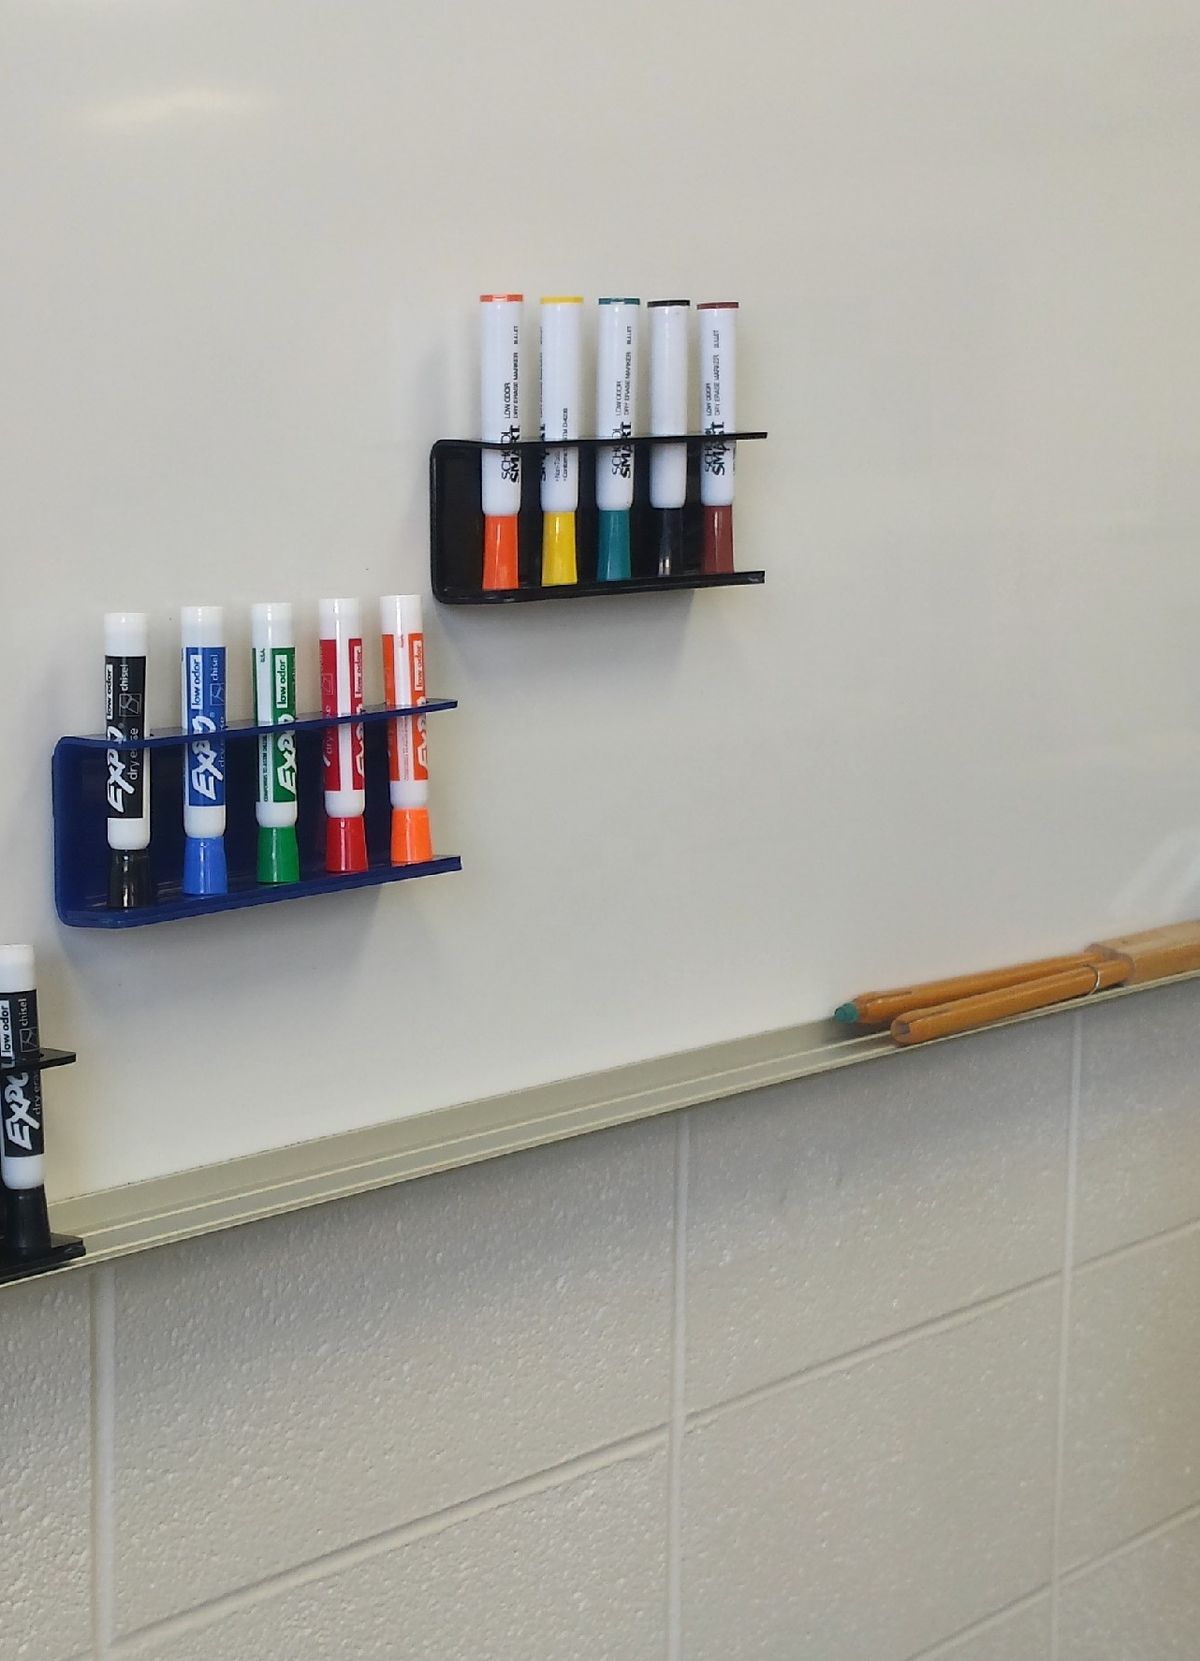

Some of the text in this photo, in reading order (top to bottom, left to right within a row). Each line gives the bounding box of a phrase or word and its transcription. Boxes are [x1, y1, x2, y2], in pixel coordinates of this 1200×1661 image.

[120, 664, 129, 692] chisel
[192, 659, 201, 706] low odor
[210, 654, 218, 681] chisel
[277, 659, 286, 704] low odor
[414, 645, 423, 687] low odor
[127, 727, 140, 780] dry ese
[192, 715, 223, 800] EXPO
[0, 1005, 11, 1052] low odor
[18, 998, 28, 1026] chisel
